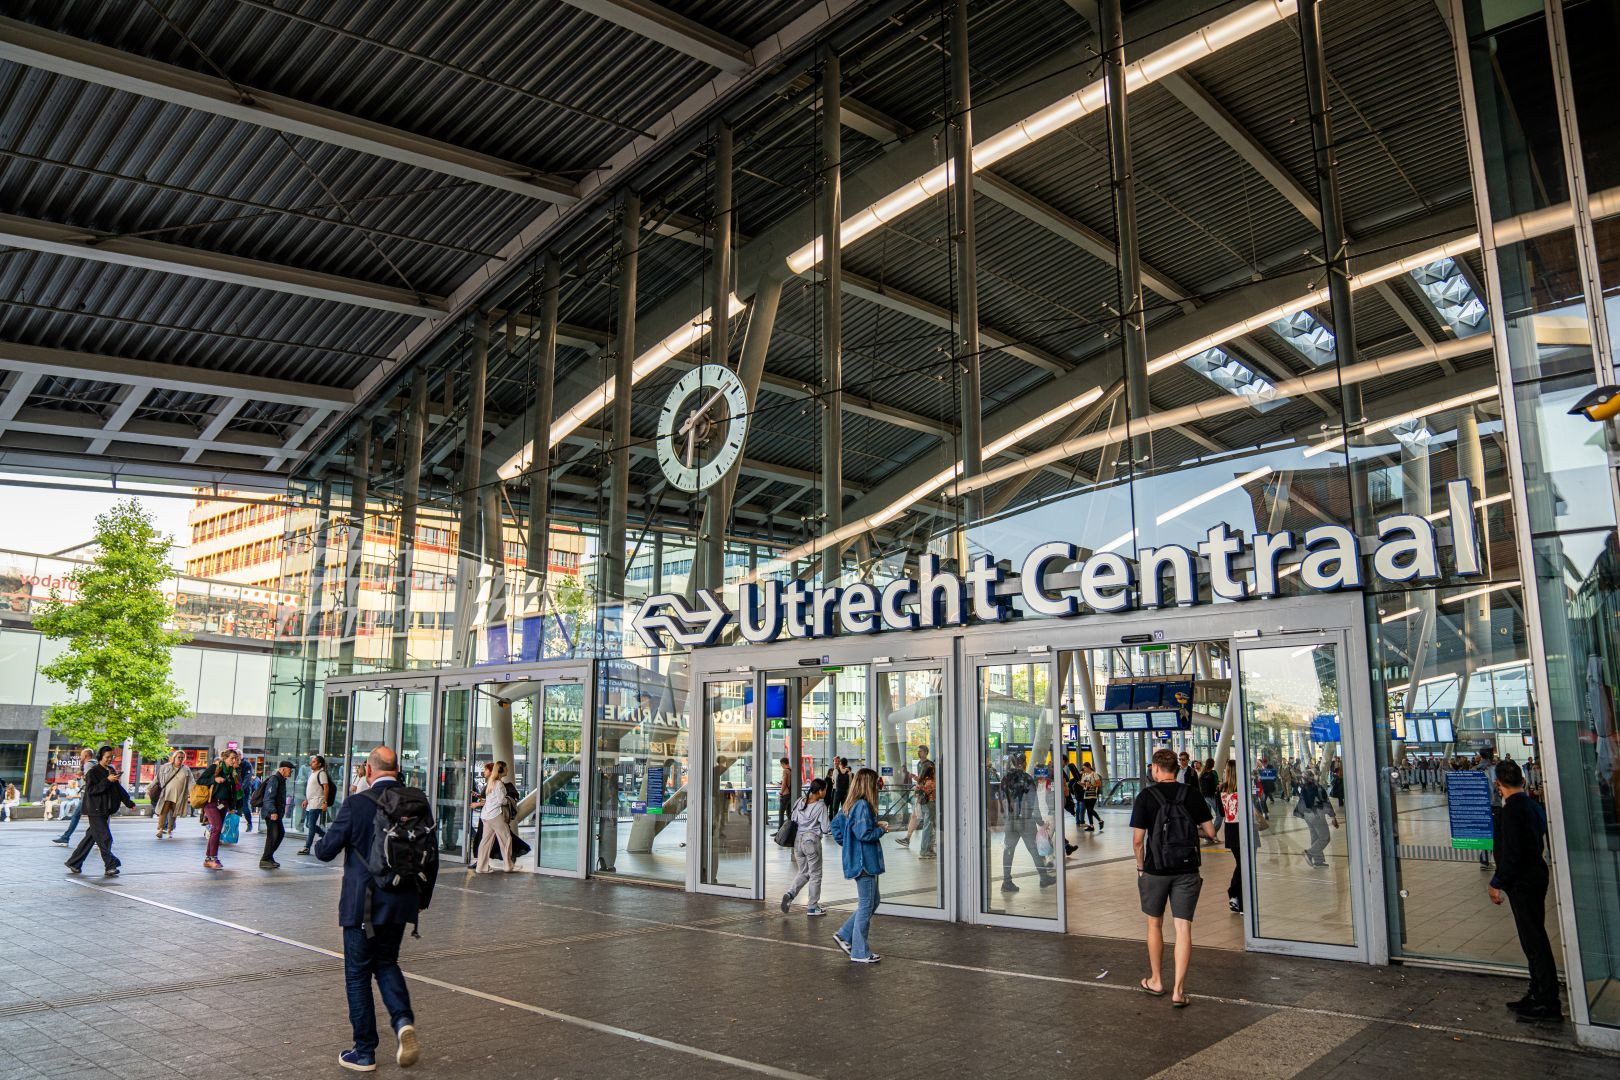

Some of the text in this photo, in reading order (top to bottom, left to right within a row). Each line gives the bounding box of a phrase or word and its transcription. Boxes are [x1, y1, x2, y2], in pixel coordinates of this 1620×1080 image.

[19, 574, 78, 591] vodafo
[739, 478, 1482, 643] Utrecht Centraal
